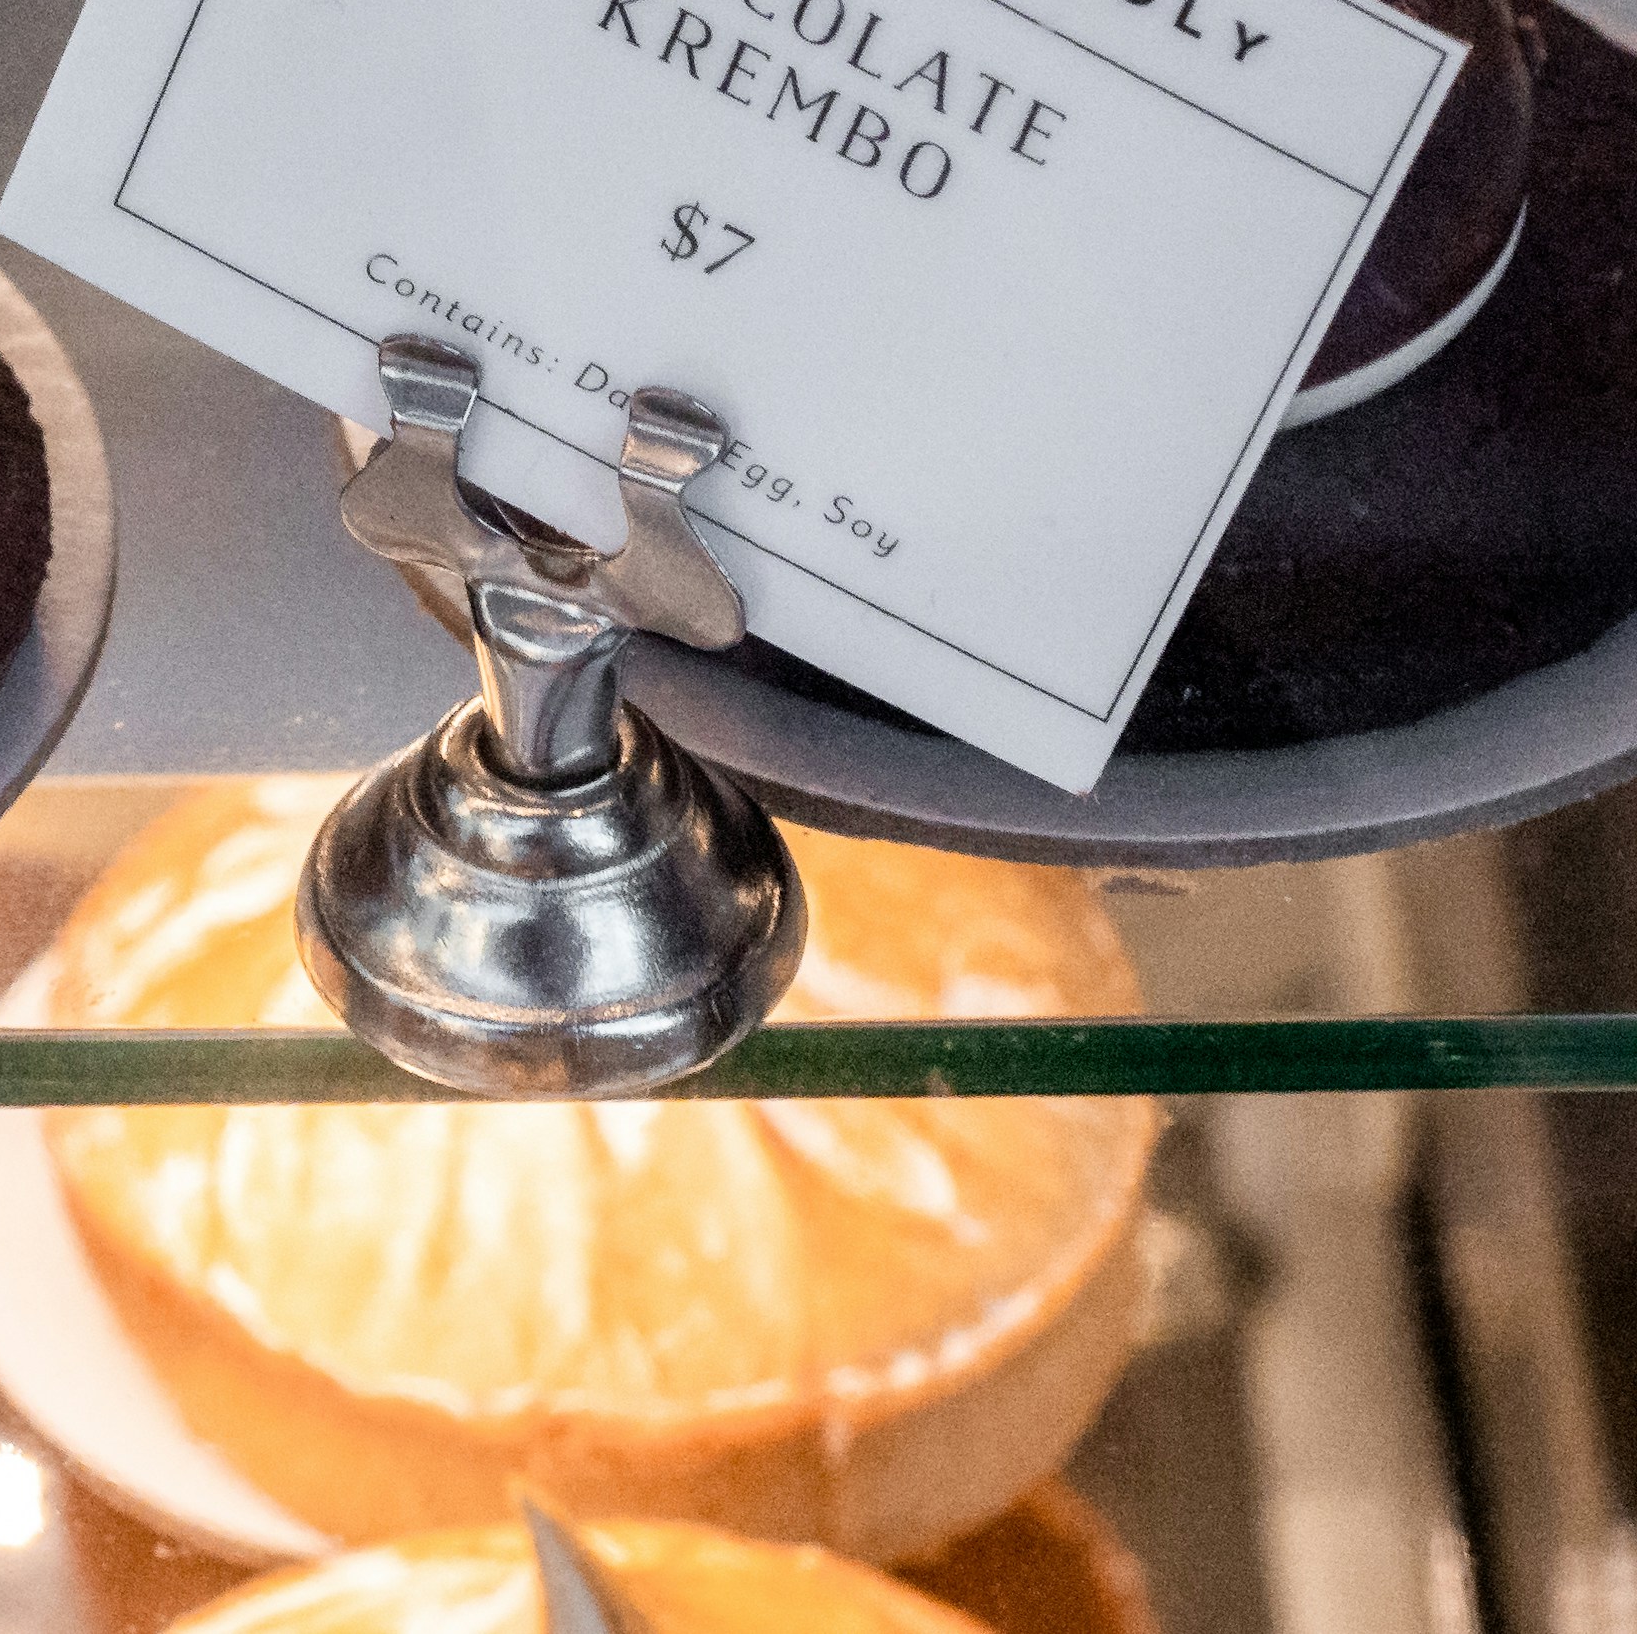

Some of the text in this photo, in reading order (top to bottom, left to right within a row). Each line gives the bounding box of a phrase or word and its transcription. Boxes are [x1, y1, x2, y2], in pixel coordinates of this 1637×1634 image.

[660, 200, 756, 274] $7
[365, 253, 901, 559] Contains: Egg, Soy
